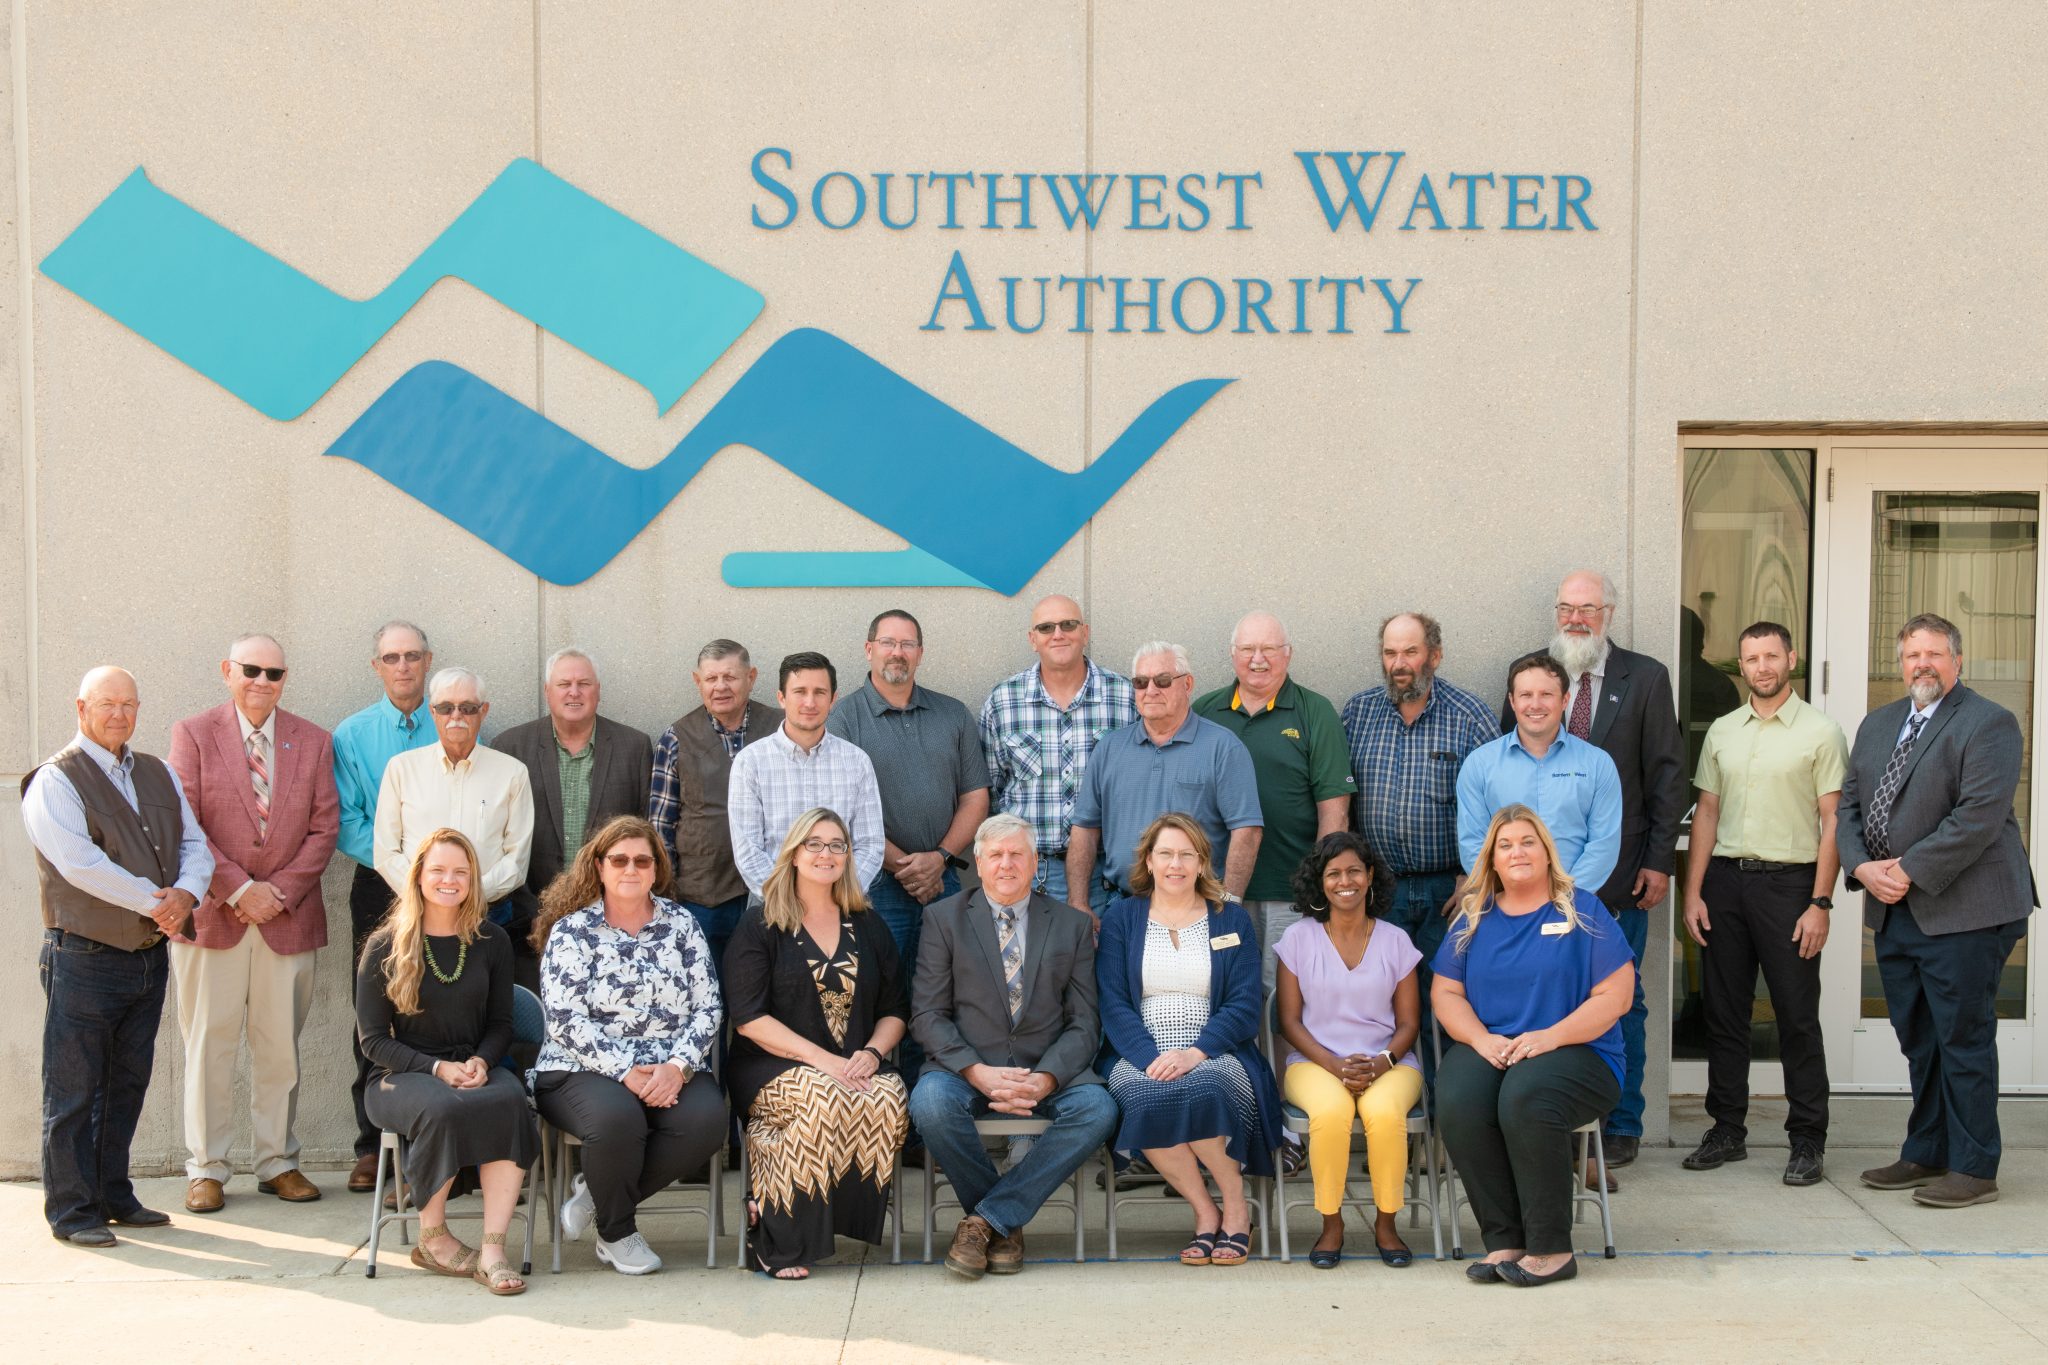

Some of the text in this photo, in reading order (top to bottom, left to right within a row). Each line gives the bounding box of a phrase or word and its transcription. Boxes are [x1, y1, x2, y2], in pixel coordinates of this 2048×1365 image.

[750, 147, 1598, 232] SOUTHWEST WATER
[919, 251, 1422, 333] AUTHORITY
